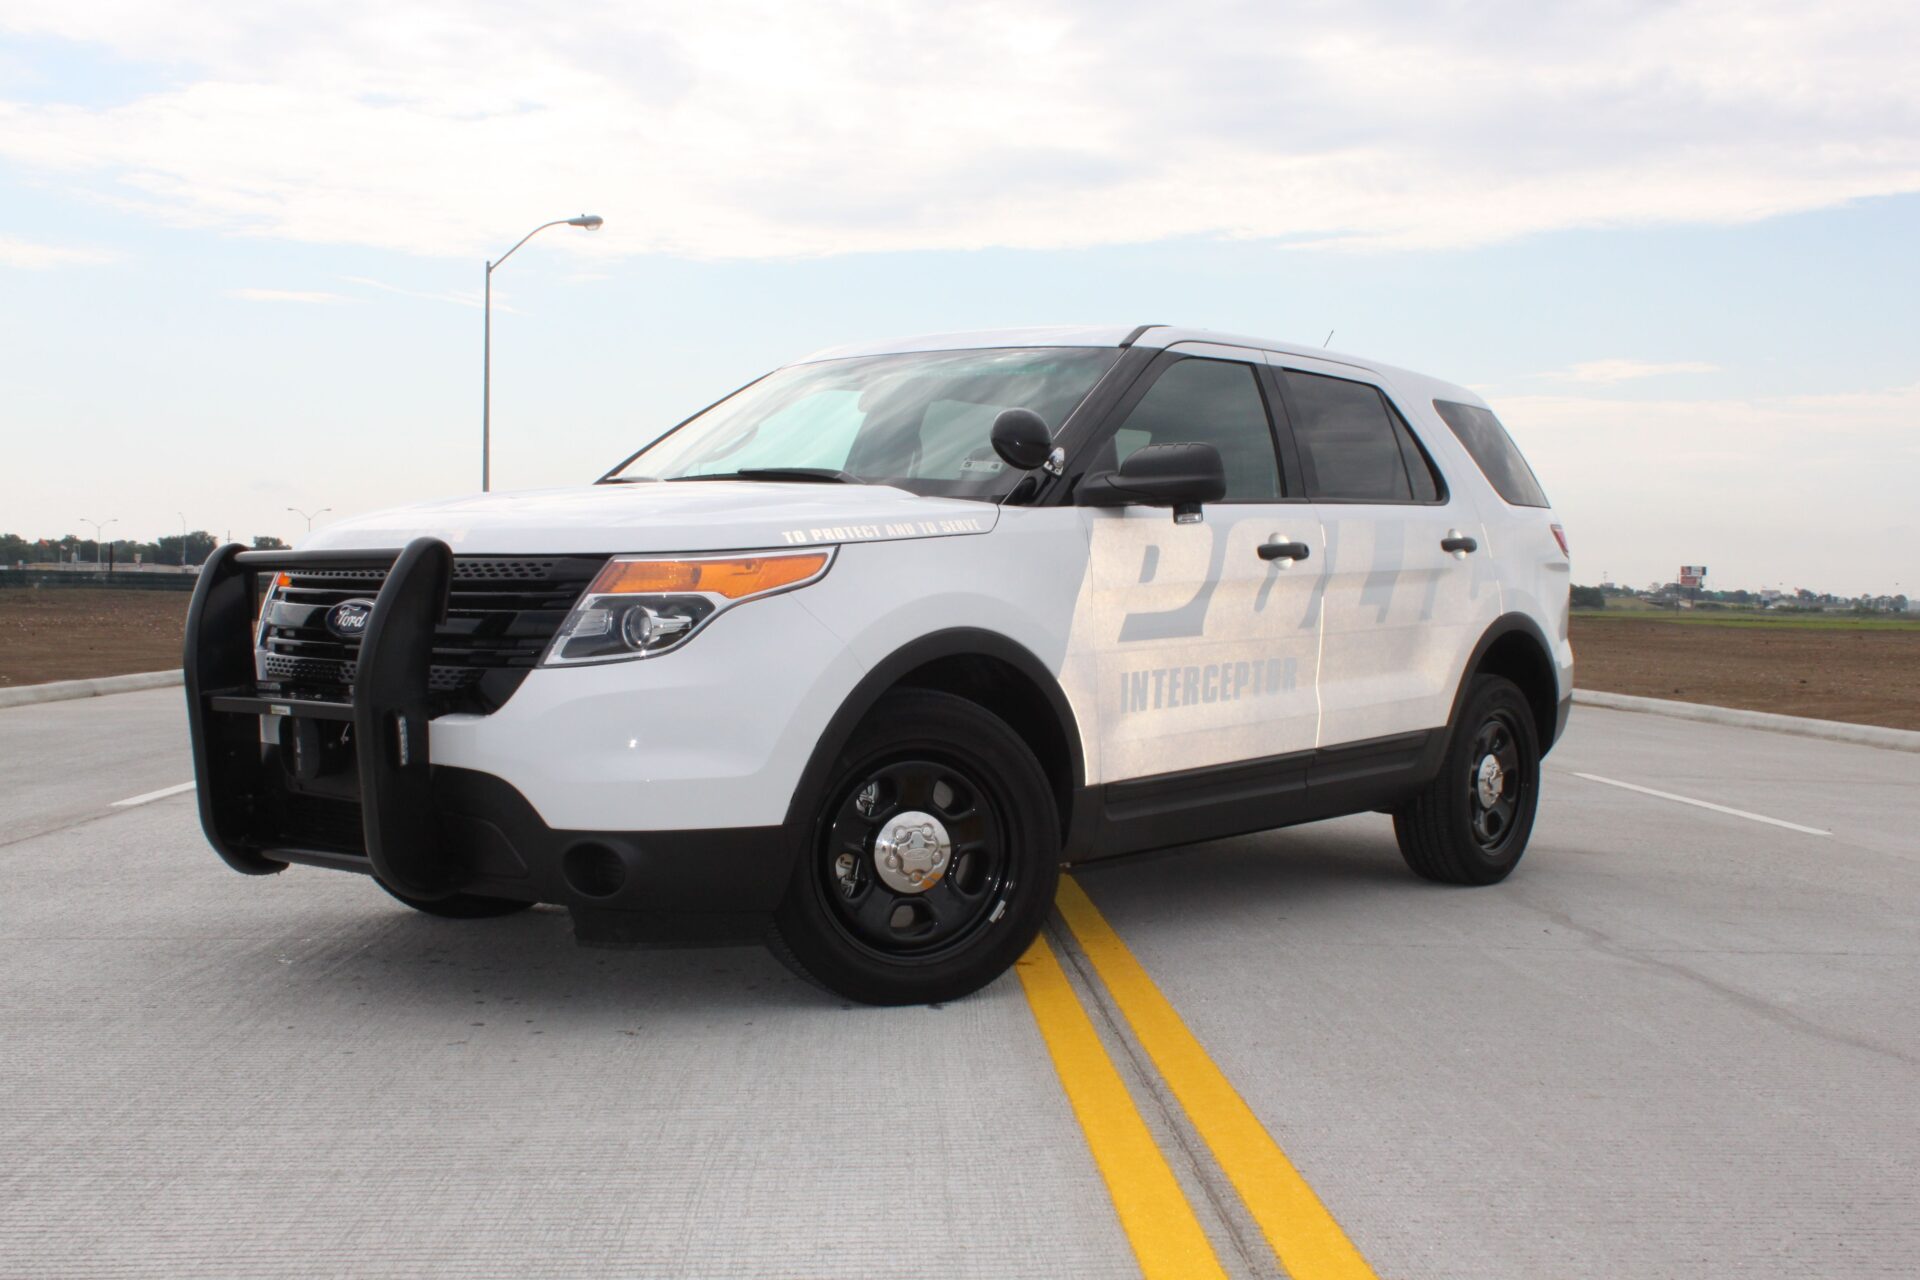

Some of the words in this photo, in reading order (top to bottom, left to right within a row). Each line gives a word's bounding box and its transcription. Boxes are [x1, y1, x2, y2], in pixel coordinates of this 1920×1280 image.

[782, 530, 807, 544] TO
[810, 525, 881, 541] PROTECT
[885, 523, 916, 537] AND
[918, 521, 938, 535] TO
[941, 519, 981, 532] SERVE
[1064, 517, 1545, 642] POLIC
[335, 604, 368, 627] Ford
[1120, 657, 1298, 714] INTERCEPTOR
